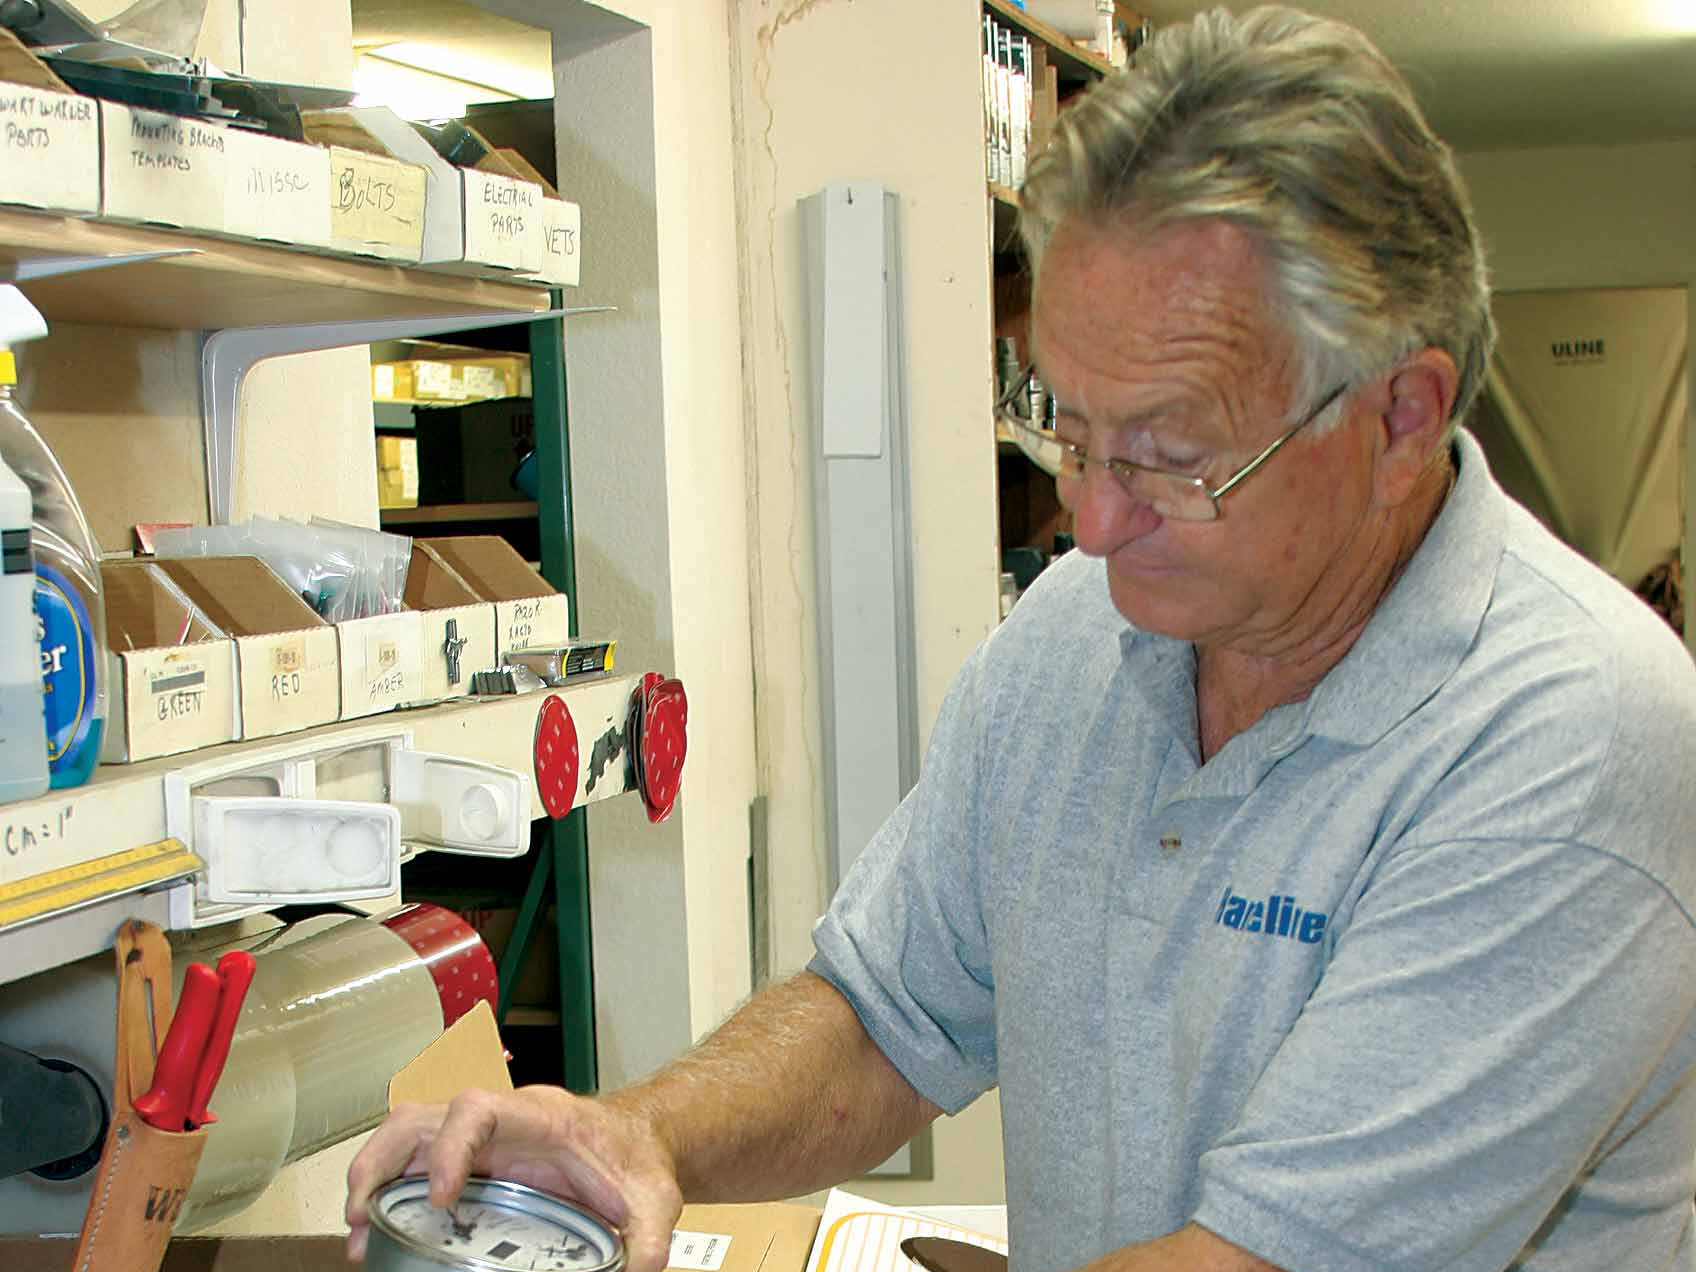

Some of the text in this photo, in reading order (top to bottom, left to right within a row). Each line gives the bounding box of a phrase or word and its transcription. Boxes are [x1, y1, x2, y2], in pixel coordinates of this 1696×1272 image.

[491, 212, 524, 236] PARTS
[544, 225, 575, 255] VETS
[1551, 339, 1604, 357] ULINE
[271, 673, 300, 703] RED
